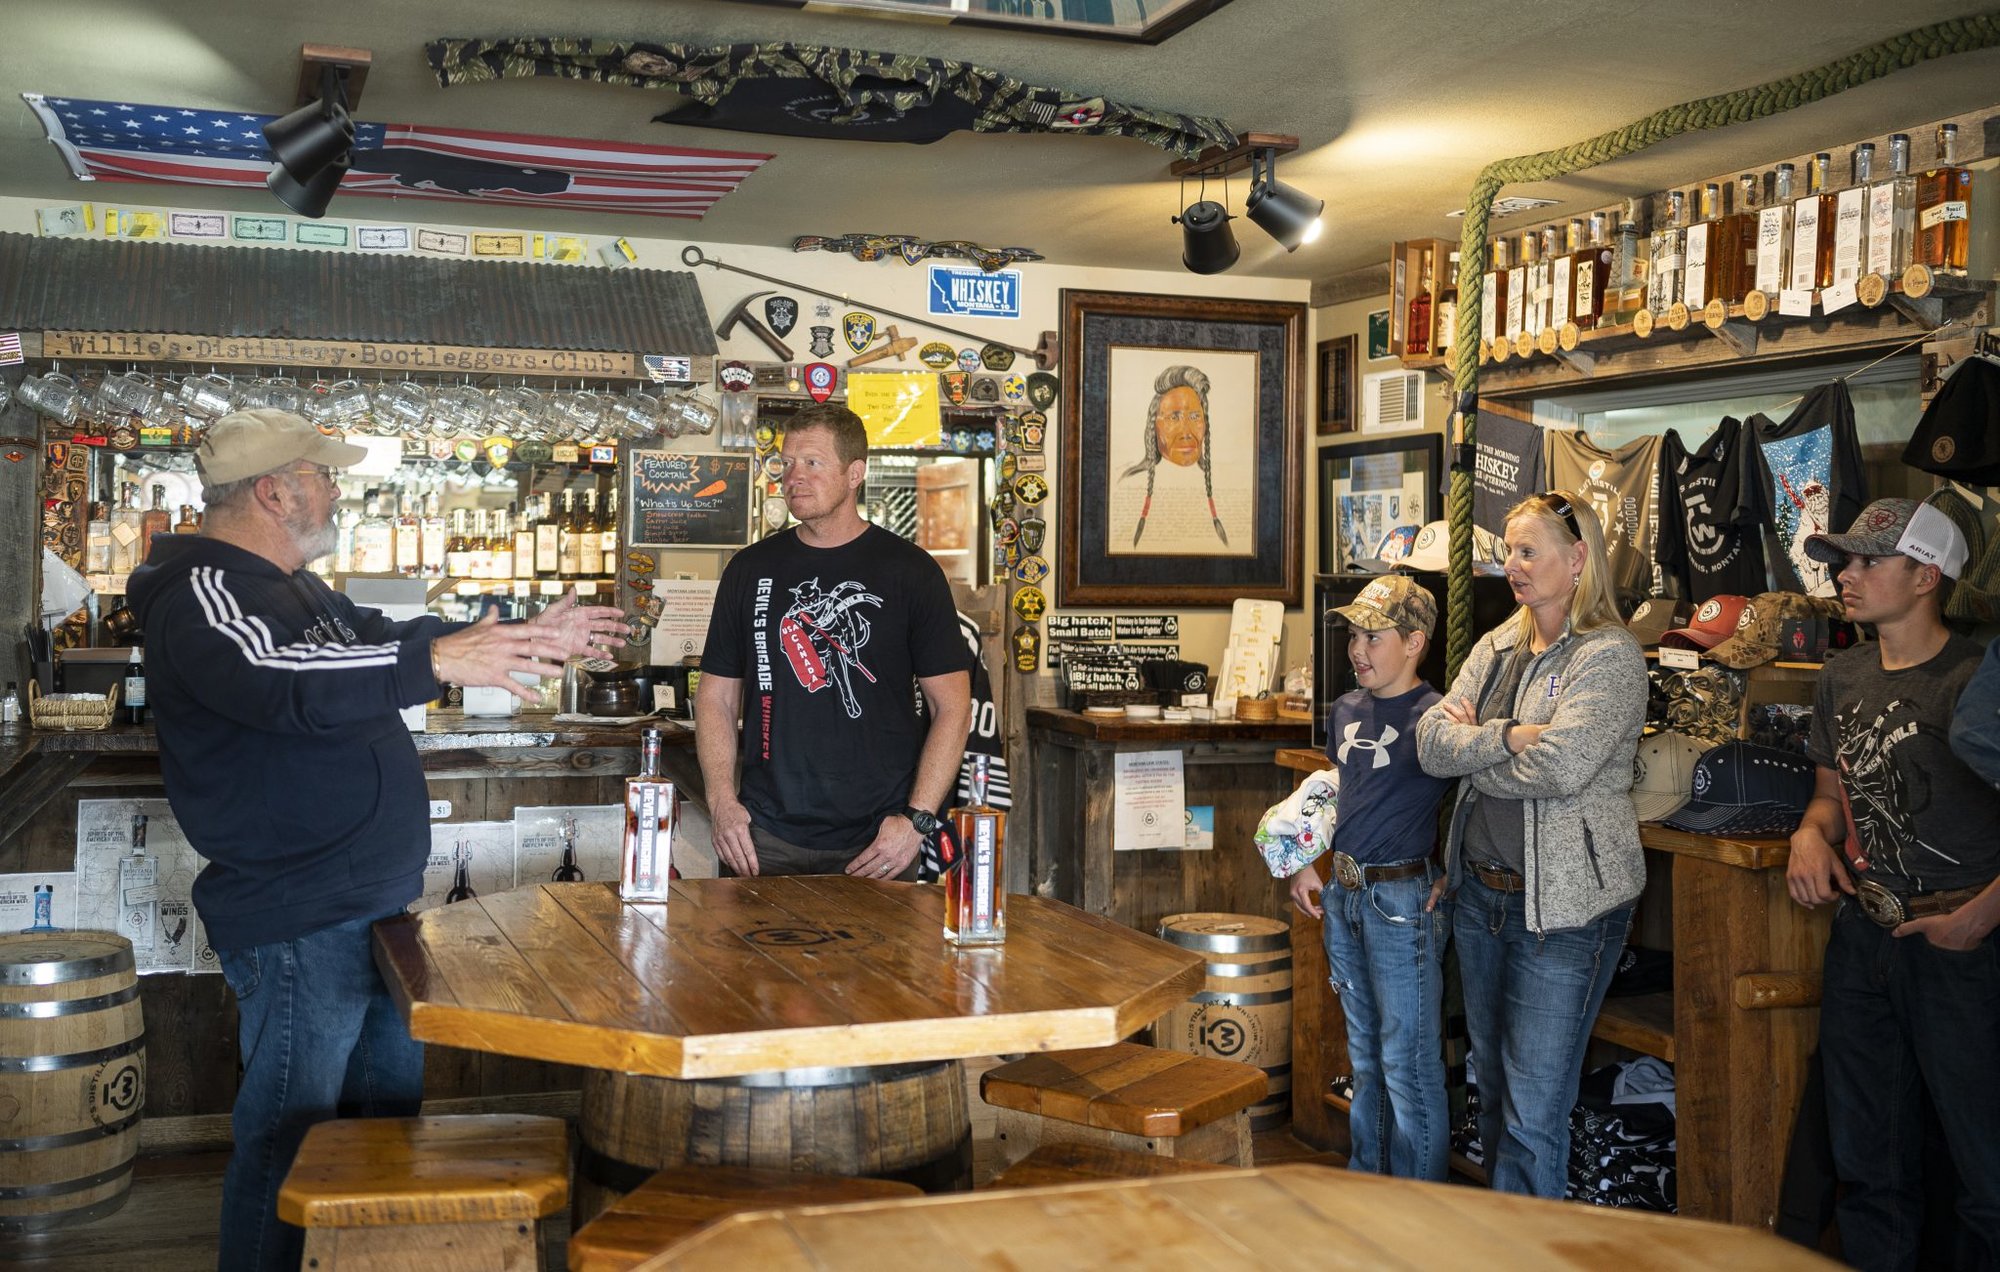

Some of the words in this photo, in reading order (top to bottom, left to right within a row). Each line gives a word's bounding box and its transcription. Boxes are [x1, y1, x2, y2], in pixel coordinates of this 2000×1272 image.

[951, 278, 1010, 304] WHISKEY
[956, 301, 995, 309] MONTANA
[69, 335, 181, 358] Willie's
[196, 339, 347, 366] Distillery
[360, 344, 536, 369] Bootleggers
[551, 351, 614, 373] Club
[522, 449, 546, 457] SWAT
[1483, 444, 1494, 454] THE
[1494, 448, 1520, 463] MORNING
[644, 459, 688, 470] FEATURED
[1475, 452, 1519, 482] HISKEY
[681, 501, 693, 510] Up
[1692, 522, 1716, 543] W
[1711, 536, 1742, 573] MONTAN
[1909, 544, 1936, 560] ARIAT
[754, 578, 773, 627] DEVIL'S
[782, 625, 800, 635] USA
[1048, 616, 1069, 628] Big
[1071, 616, 1112, 627] hatch,
[1049, 628, 1078, 637] Small
[1080, 627, 1111, 637] Batch
[1116, 617, 1134, 626] Whiskey
[754, 632, 773, 691] BRIGADE
[791, 634, 818, 683] CANADA
[912, 674, 923, 717] LLERY
[643, 788, 655, 828] DEVIL'S
[977, 819, 991, 865] DEVIL'S
[161, 907, 188, 916] WINGS
[1221, 1026, 1235, 1048] W
